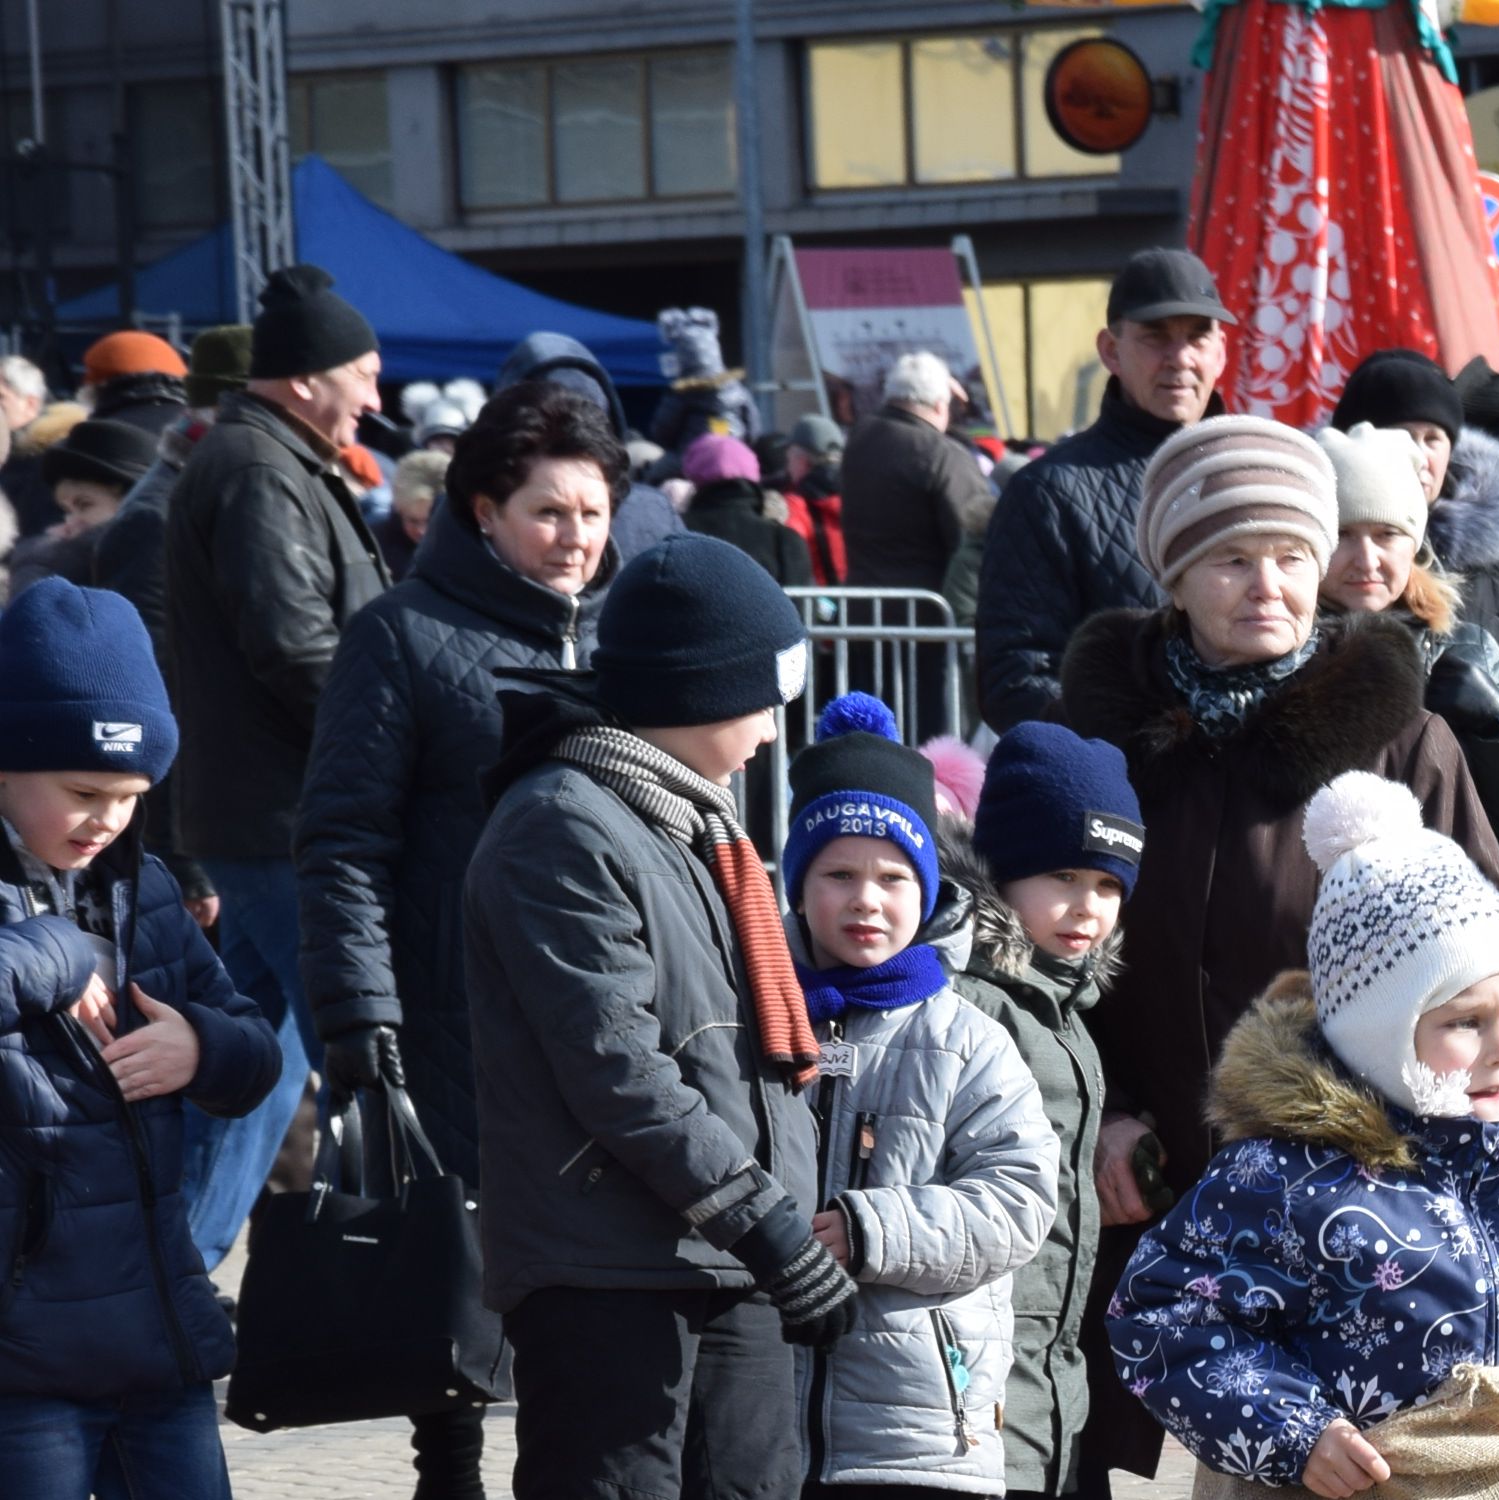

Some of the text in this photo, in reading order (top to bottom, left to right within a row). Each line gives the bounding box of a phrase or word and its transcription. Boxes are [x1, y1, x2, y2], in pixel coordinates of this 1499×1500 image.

[102, 742, 135, 752] NIKE
[805, 803, 924, 849] DAUGAVPILS
[840, 819, 886, 836] 2013
[1090, 819, 1143, 853] Supreme
